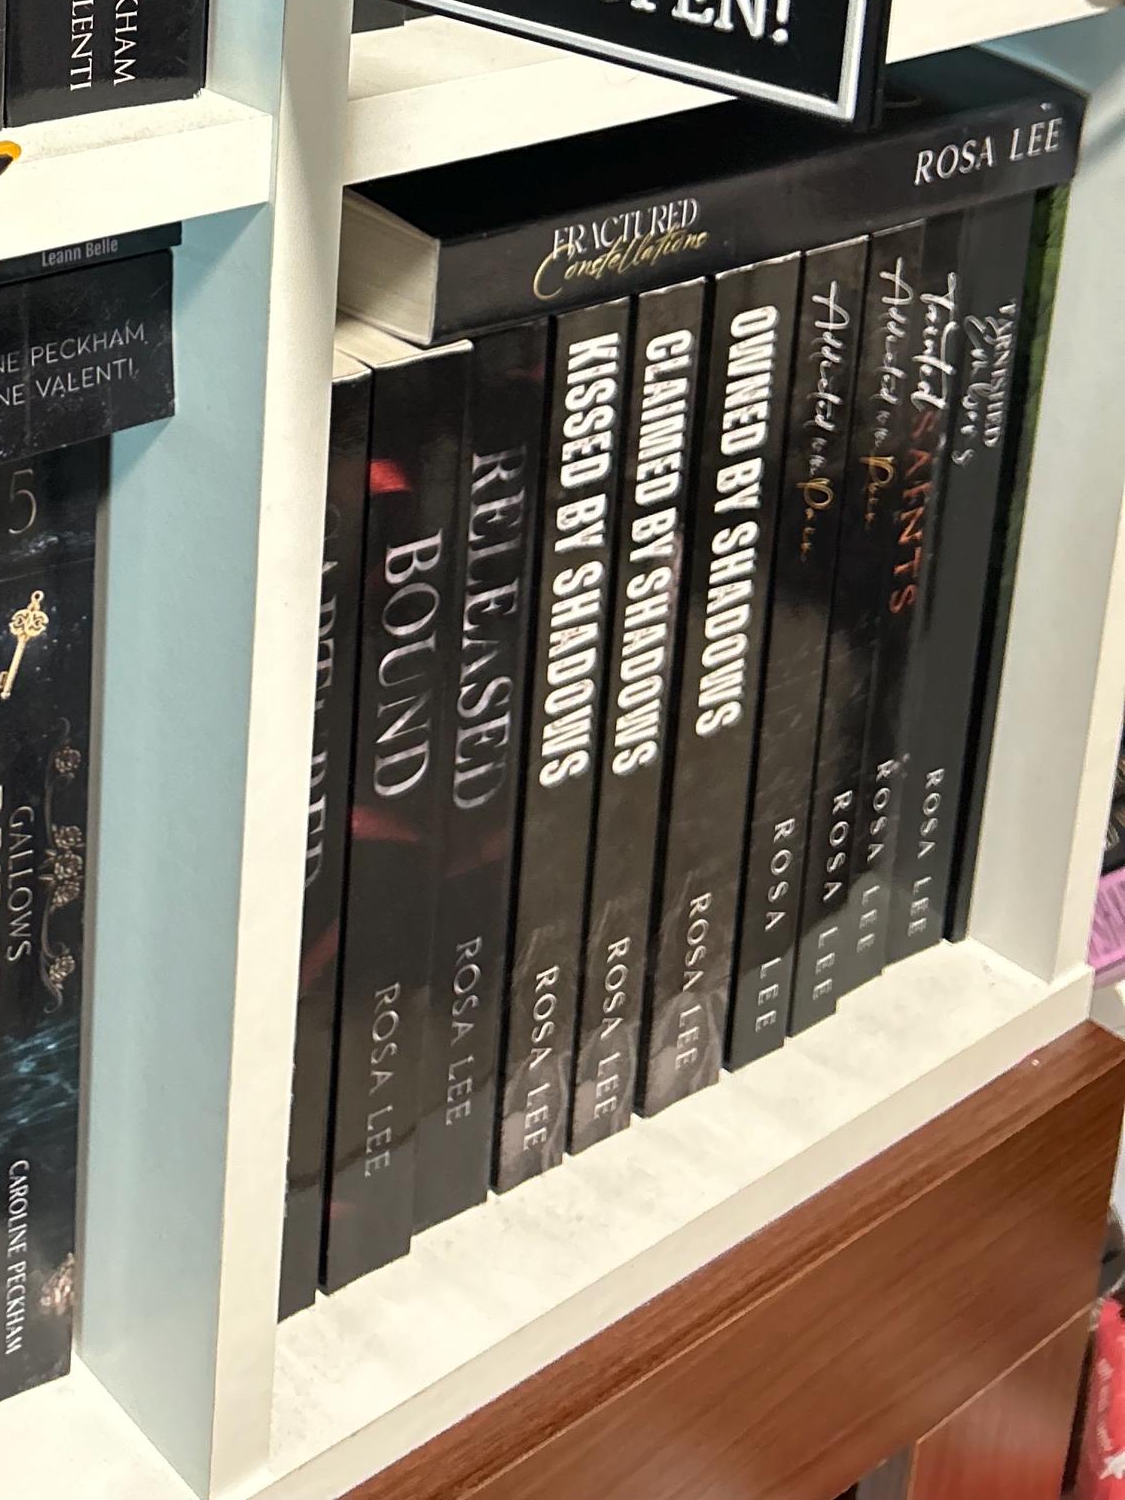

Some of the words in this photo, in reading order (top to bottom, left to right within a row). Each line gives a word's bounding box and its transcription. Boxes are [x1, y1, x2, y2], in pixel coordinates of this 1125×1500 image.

[913, 134, 995, 187] ROSA
[1008, 117, 1065, 164] LEE
[41, 246, 82, 268] Leann
[85, 238, 119, 258] Belle
[552, 197, 699, 260] FRACTURED
[31, 322, 144, 367] PECKHAM
[35, 357, 134, 399] VALENTI
[719, 305, 781, 458] OWNED
[560, 332, 623, 489] KISSED
[634, 329, 694, 514] CLAIMED
[7, 468, 37, 535] 5
[554, 493, 608, 553] BY
[715, 455, 767, 515] BY
[627, 510, 678, 565] BY
[373, 528, 446, 801] BOUND
[453, 442, 529, 811] RELEASED
[539, 560, 605, 788] SHADOWS
[612, 565, 673, 775] SHADOWS
[695, 518, 759, 737] SHADOWS
[822, 789, 855, 905] ROSA
[865, 759, 894, 865] ROSA
[915, 765, 947, 860] ROSA
[6, 804, 35, 962] GALLOWS
[763, 817, 797, 933] ROSA
[855, 884, 882, 955] LEE
[906, 875, 932, 938] LEE
[599, 935, 633, 1040] ROSA
[679, 892, 714, 993] ROSA
[812, 926, 837, 1003] LEE
[369, 979, 402, 1098] ROSA
[450, 935, 484, 1048] ROSA
[530, 965, 561, 1071] ROSA
[672, 1001, 702, 1073] LEE
[753, 957, 782, 1034] LEE
[445, 1054, 474, 1127] LEE
[521, 1081, 550, 1154] LEE
[591, 1050, 620, 1123] LEE
[364, 1107, 392, 1179] LEE
[6, 1158, 31, 1259] CAROLINE
[5, 1261, 30, 1356] PECKHAM
